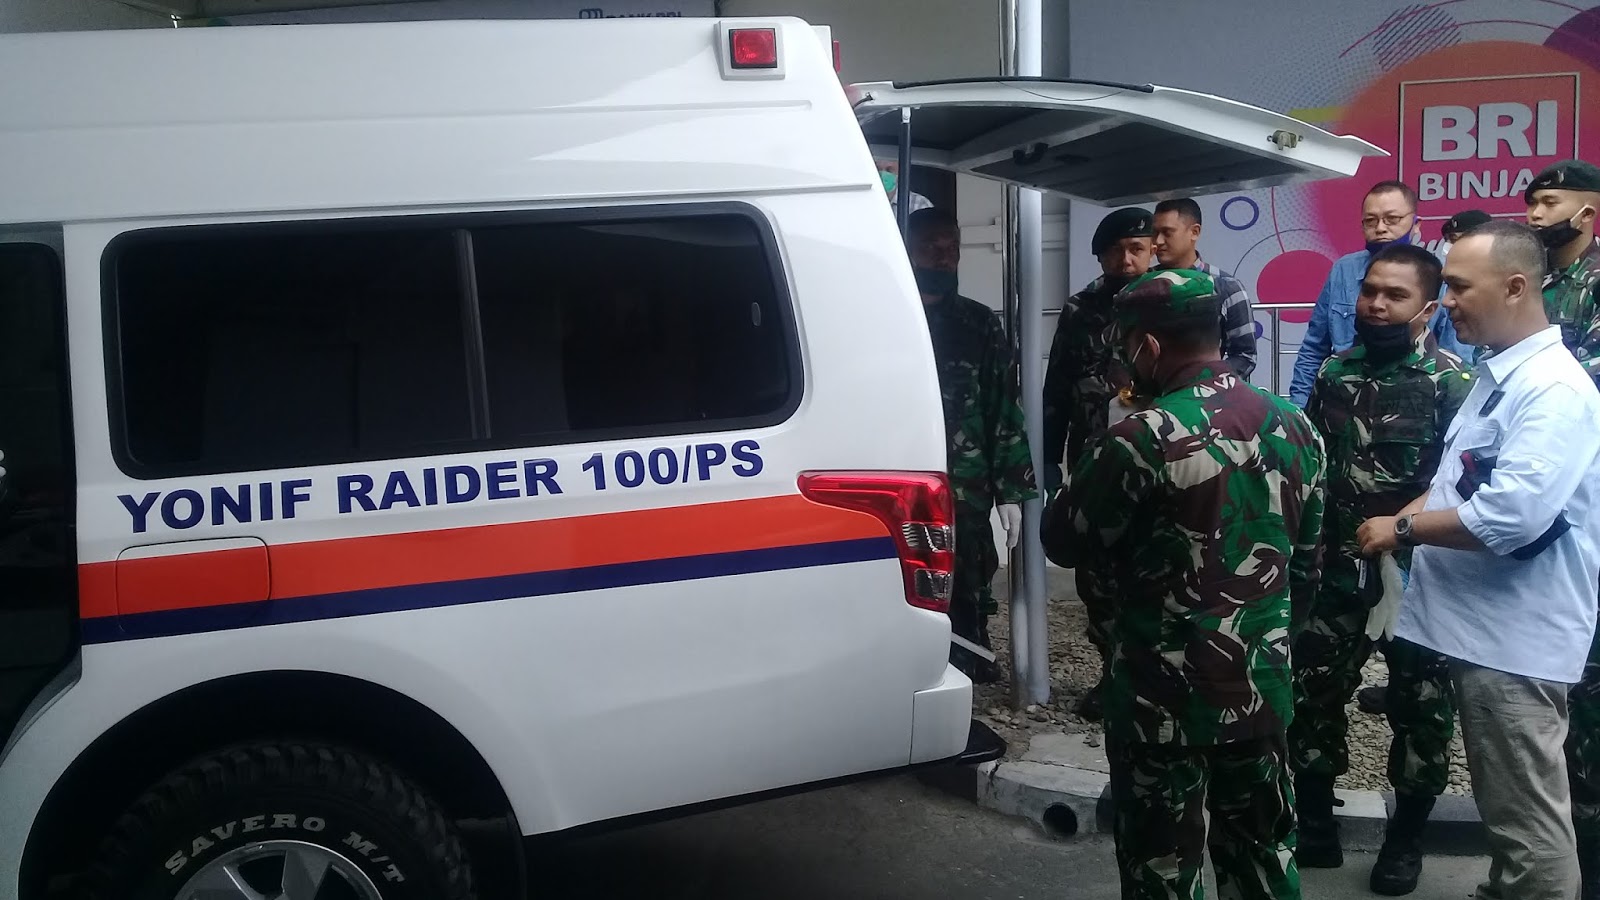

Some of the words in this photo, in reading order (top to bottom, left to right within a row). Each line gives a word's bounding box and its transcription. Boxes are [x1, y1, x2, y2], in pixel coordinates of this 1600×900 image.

[1422, 100, 1557, 161] BRI
[1418, 168, 1534, 201] BINJA
[117, 478, 313, 533] YONIF
[337, 457, 564, 514] RAIDER
[581, 439, 764, 491] 100/PS
[164, 813, 326, 876] SAVERO
[341, 831, 406, 883] M/T
